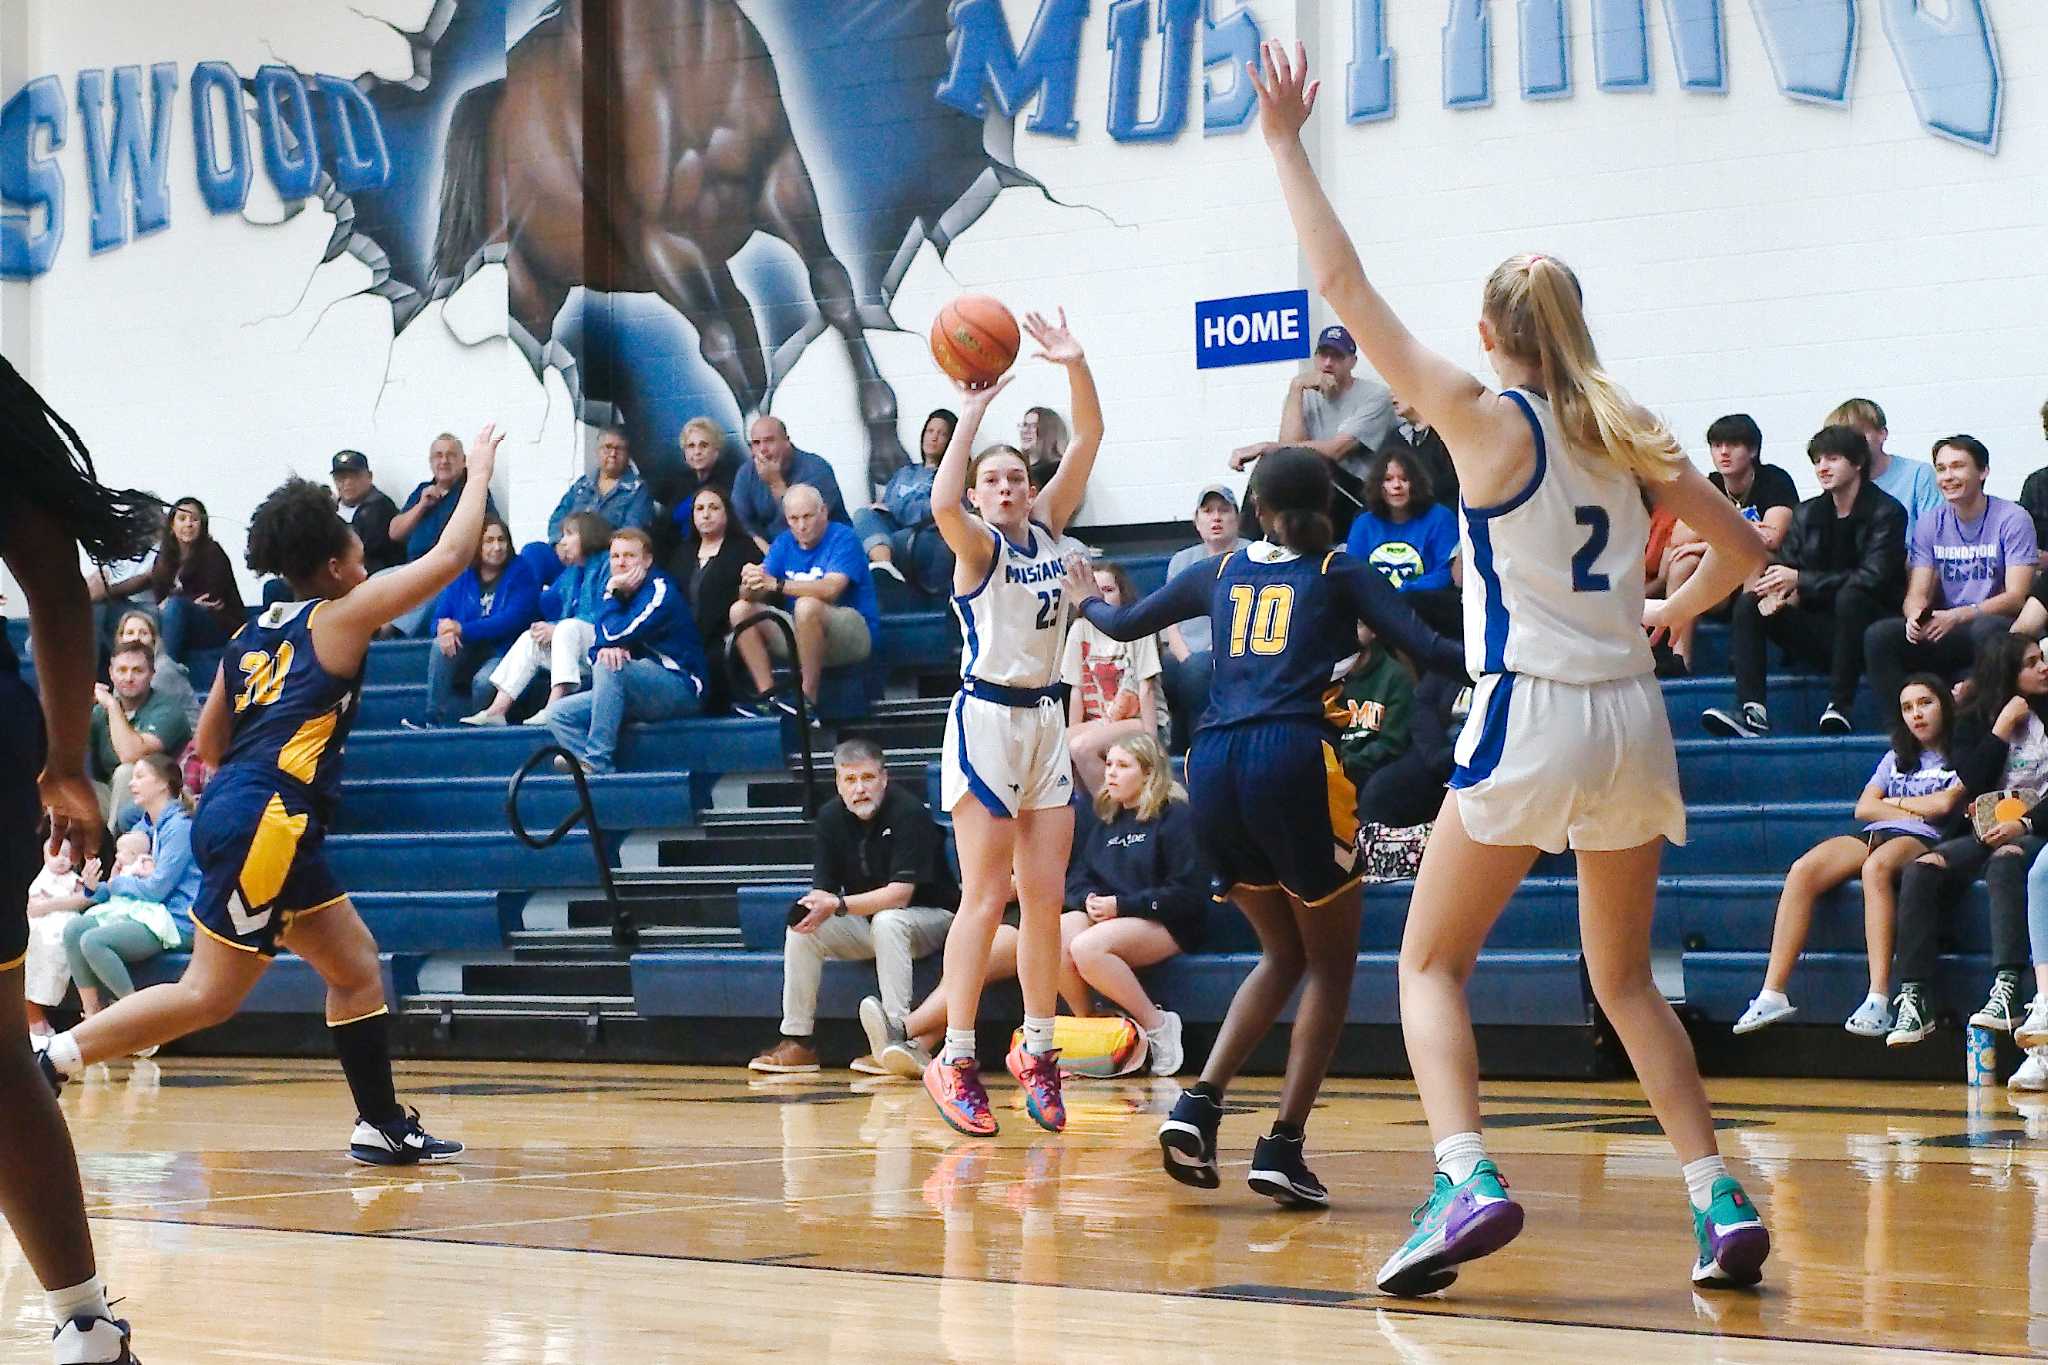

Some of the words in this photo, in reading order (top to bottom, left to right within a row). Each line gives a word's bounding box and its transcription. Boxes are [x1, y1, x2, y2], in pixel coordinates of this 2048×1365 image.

[1203, 308, 1300, 349] HOME
[1571, 505, 1610, 591] 2
[1229, 584, 1294, 657] 10
